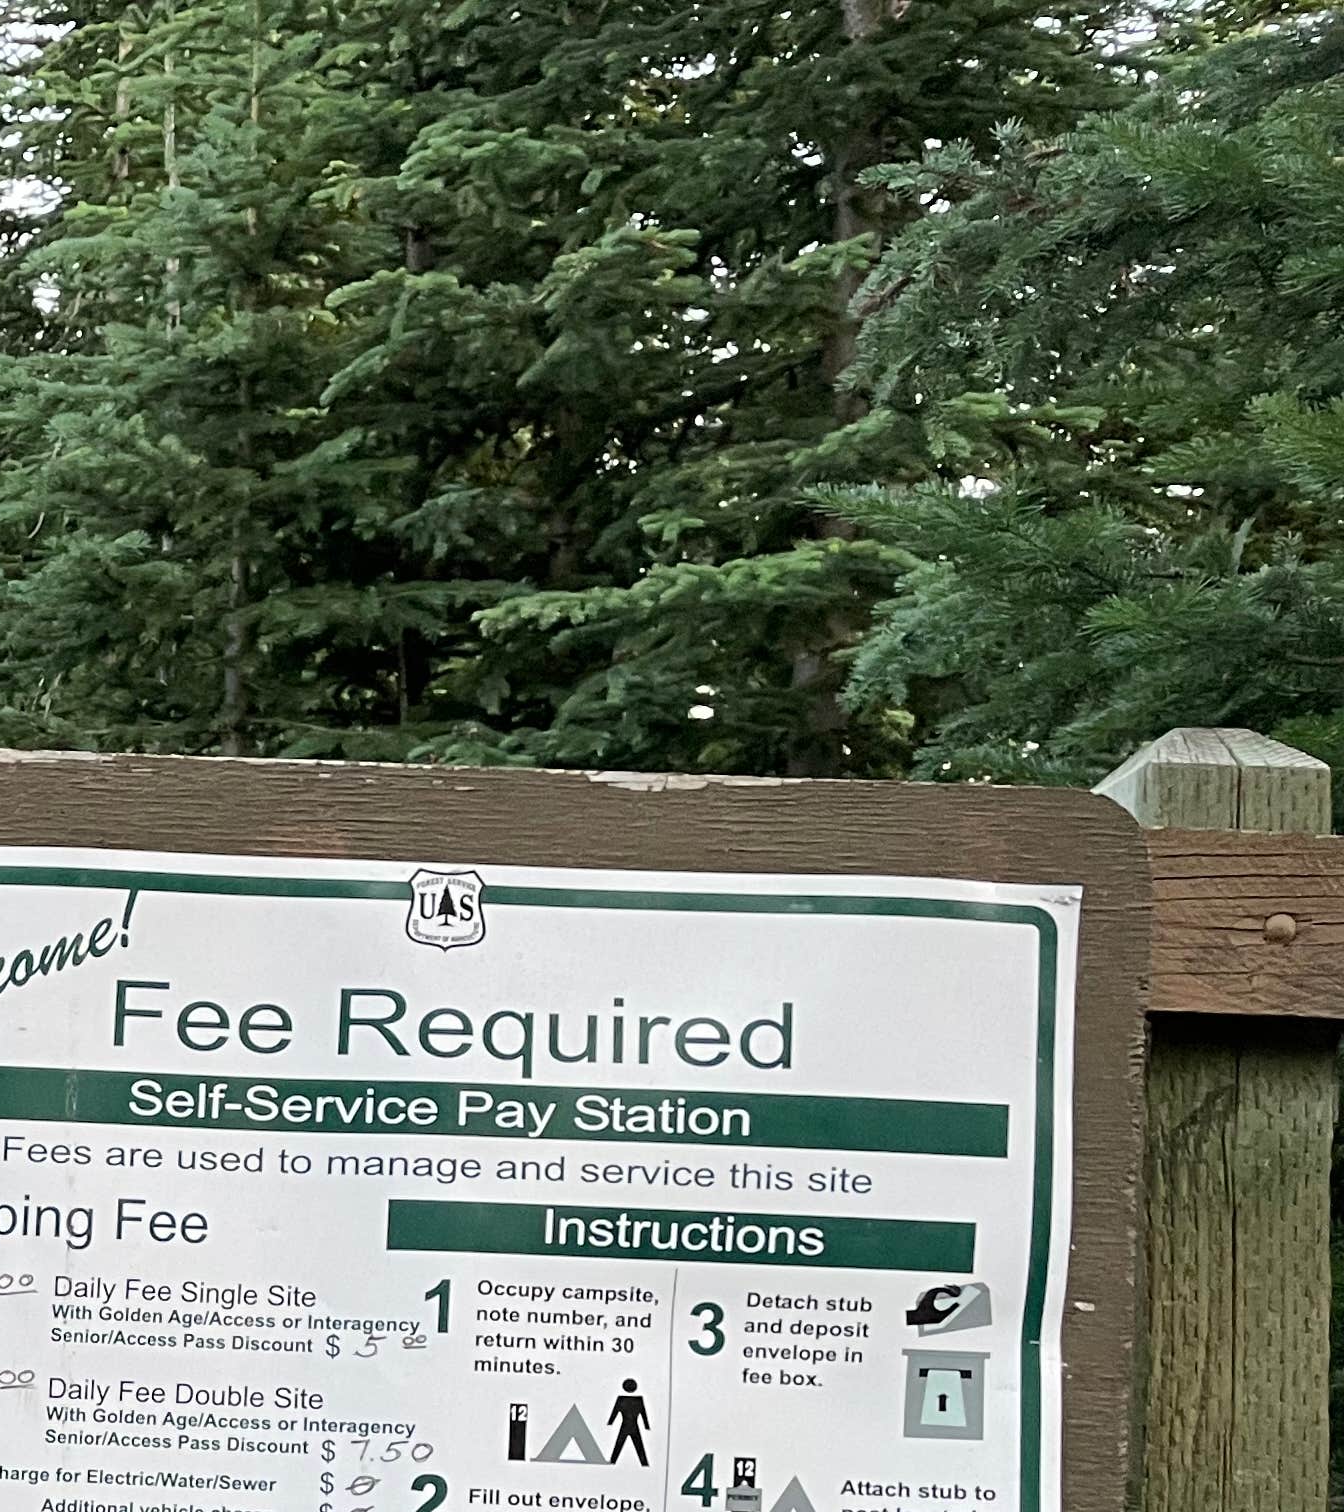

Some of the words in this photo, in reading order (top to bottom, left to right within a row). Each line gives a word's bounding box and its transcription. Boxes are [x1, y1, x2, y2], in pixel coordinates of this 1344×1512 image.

[114, 980, 292, 1053] Fee
[338, 989, 792, 1078] Required
[128, 1080, 439, 1125] Self-Service
[459, 1091, 556, 1137] Pay
[574, 1093, 751, 1137] Station
[4, 1136, 91, 1164] Fees
[106, 1148, 162, 1167] are
[178, 1148, 263, 1172] used
[279, 1150, 311, 1173] to
[328, 1156, 481, 1184] manage
[497, 1157, 564, 1181] and
[581, 1160, 714, 1187] service
[730, 1163, 792, 1190] this
[808, 1167, 872, 1193] site
[117, 1199, 207, 1243] Fee
[544, 1208, 825, 1256] Instructions
[55, 1276, 116, 1304] Daily
[126, 1279, 171, 1301] Fee
[181, 1282, 257, 1309] Single
[268, 1285, 316, 1307] Site
